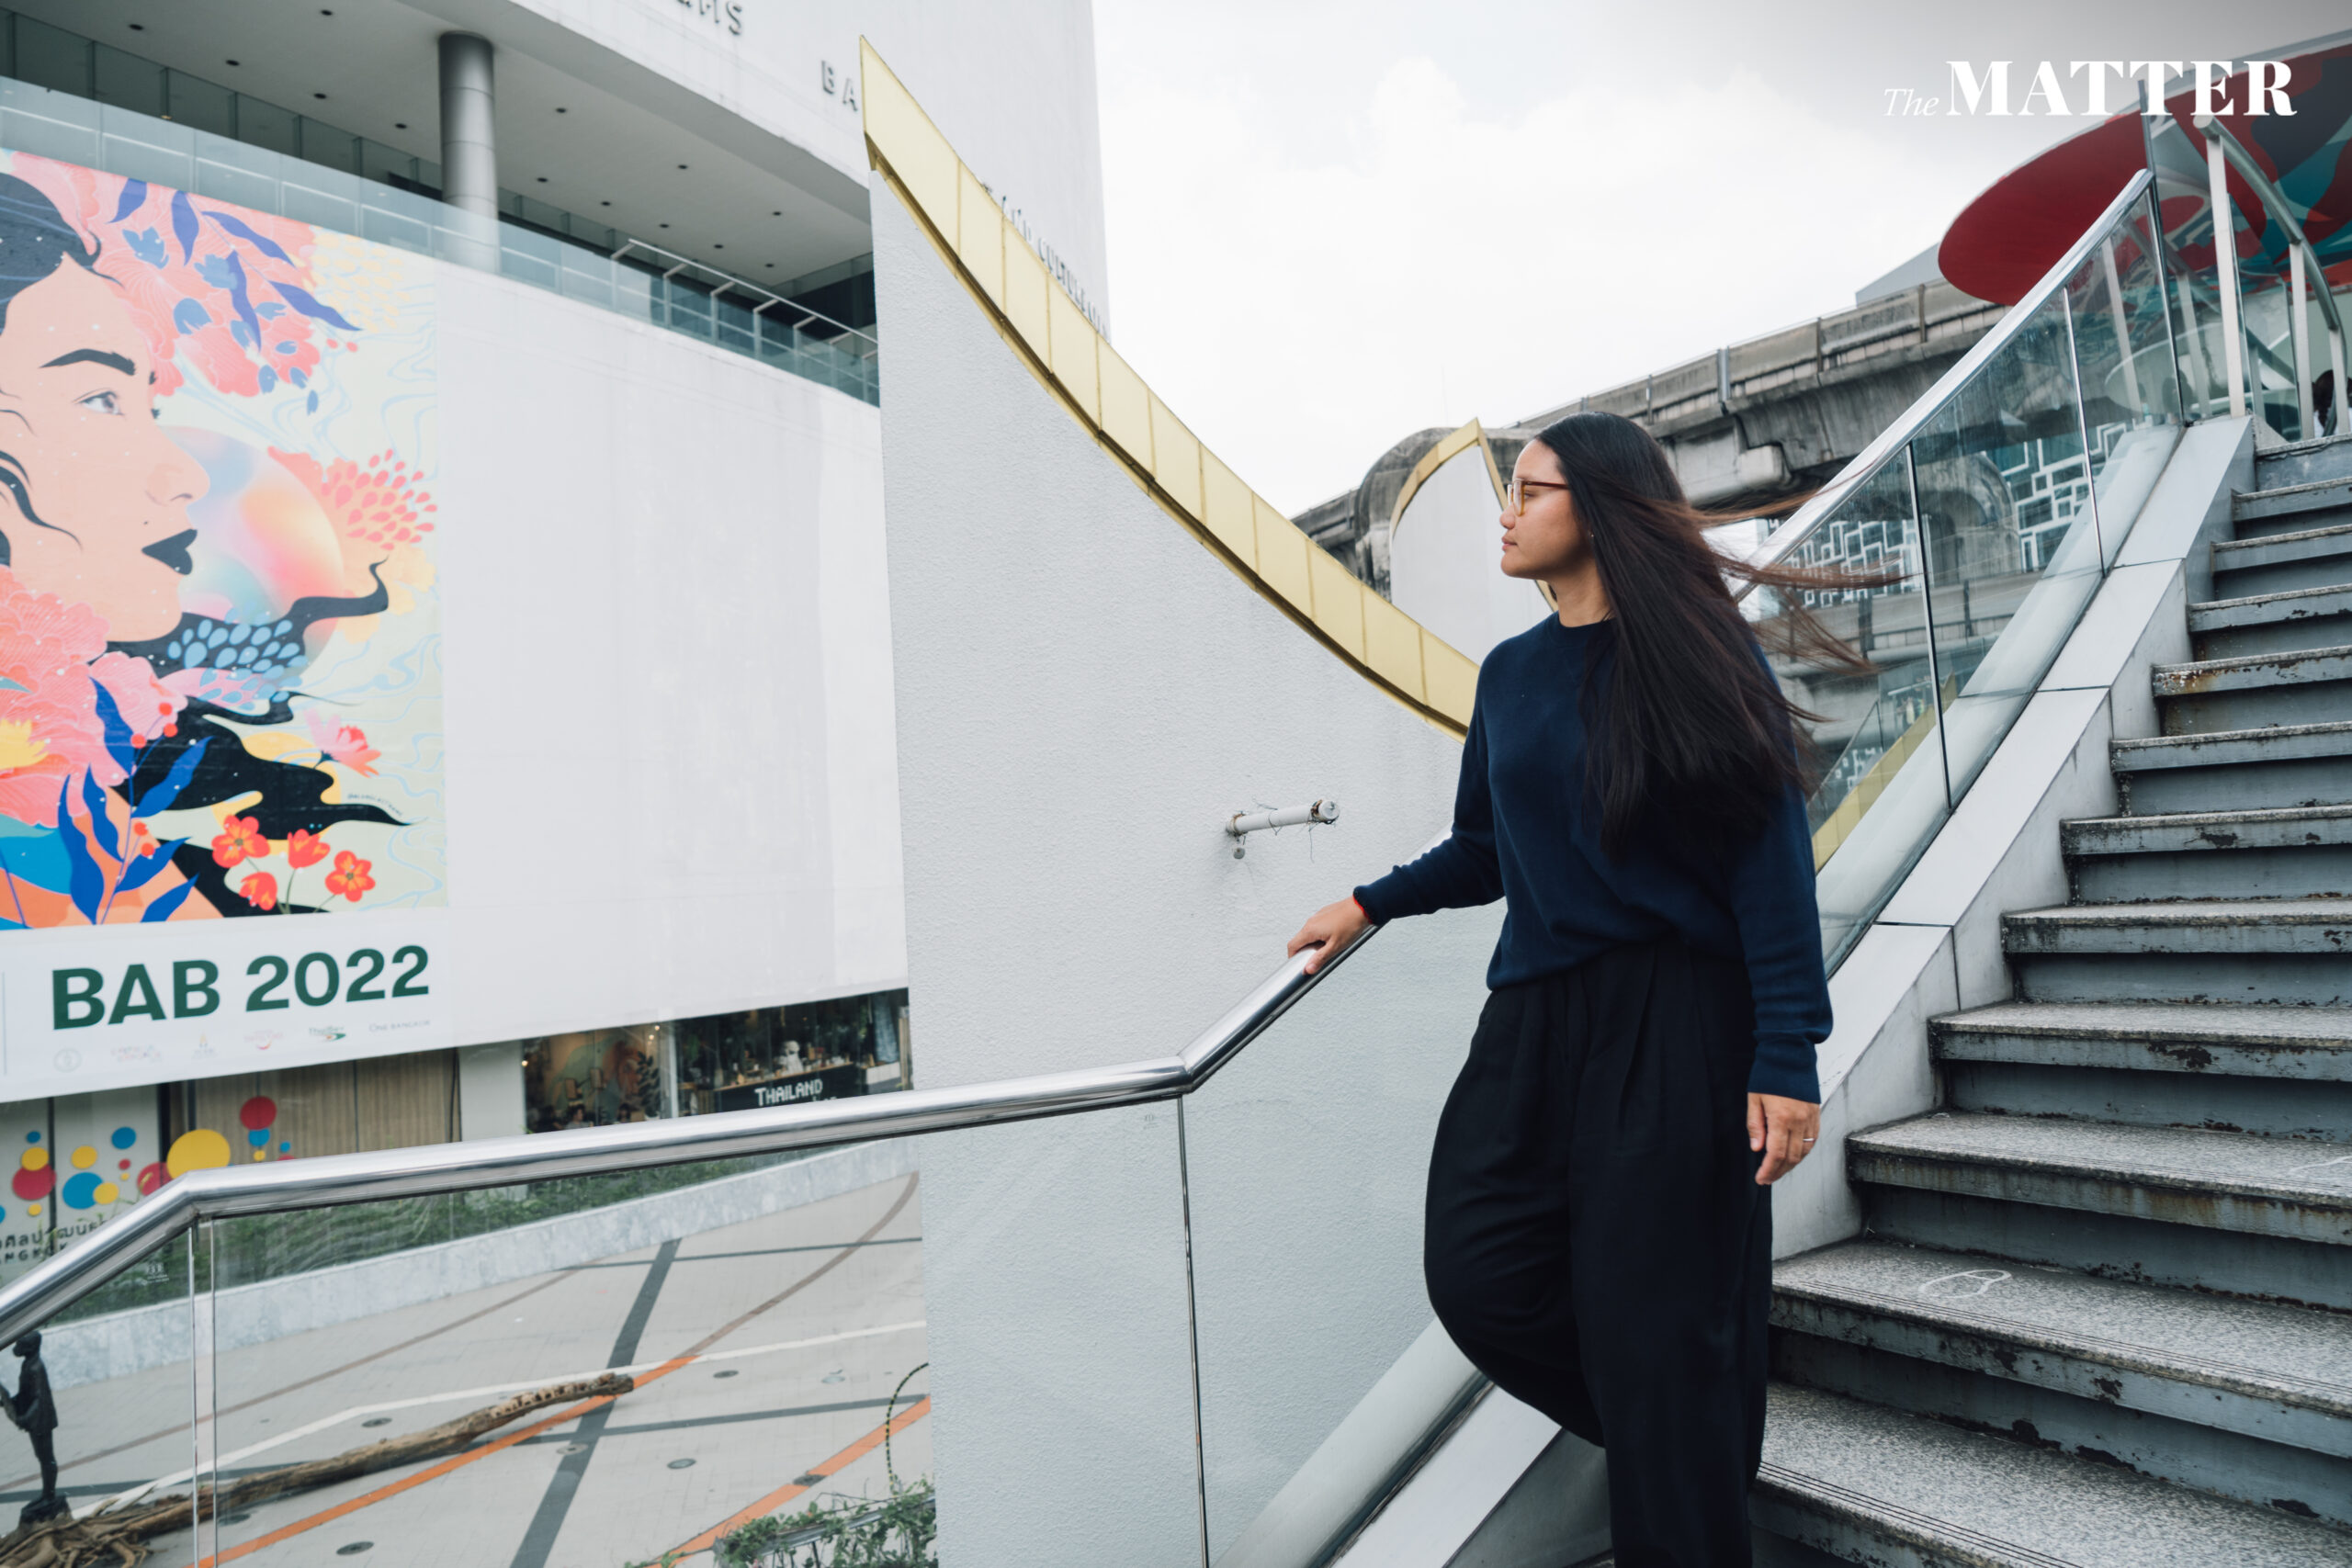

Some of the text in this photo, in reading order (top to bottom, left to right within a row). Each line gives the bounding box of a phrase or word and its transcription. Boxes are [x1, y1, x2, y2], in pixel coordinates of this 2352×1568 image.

[820, 60, 858, 112] BA
[52, 945, 429, 1030] BAB 2022
[754, 1078, 823, 1107] THAILAND
